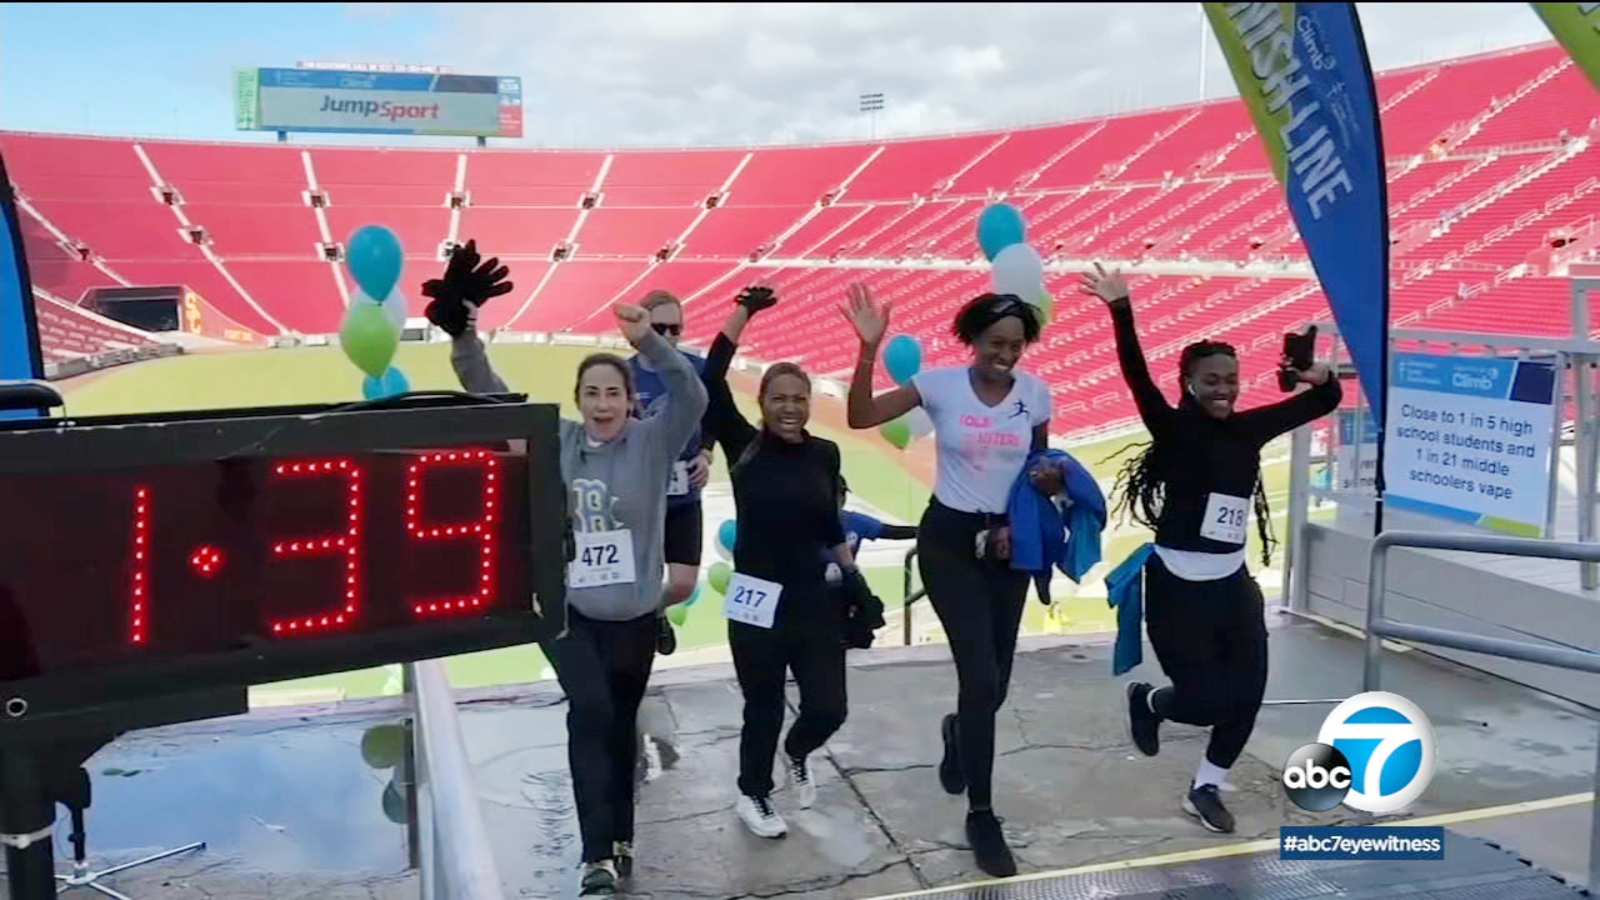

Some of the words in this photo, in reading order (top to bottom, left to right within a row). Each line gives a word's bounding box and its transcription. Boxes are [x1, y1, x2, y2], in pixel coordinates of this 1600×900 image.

[319, 94, 440, 122] JumpSport
[1280, 101, 1352, 220] LINE
[1401, 404, 1438, 421] Close
[1441, 410, 1455, 423] to
[1460, 412, 1466, 425] 1
[1471, 412, 1483, 428] in
[1487, 415, 1496, 429] 5
[1500, 417, 1533, 437] high
[1396, 426, 1439, 442] school
[1443, 433, 1503, 453] students
[1507, 443, 1535, 458] and
[1416, 447, 1422, 460] 1
[1426, 449, 1439, 463] in
[1442, 451, 1457, 466] 21
[1462, 457, 1510, 476] middle
[1409, 469, 1475, 492] schoolers
[1479, 482, 1513, 500] vape
[582, 544, 620, 567] 472
[733, 585, 767, 608] 217
